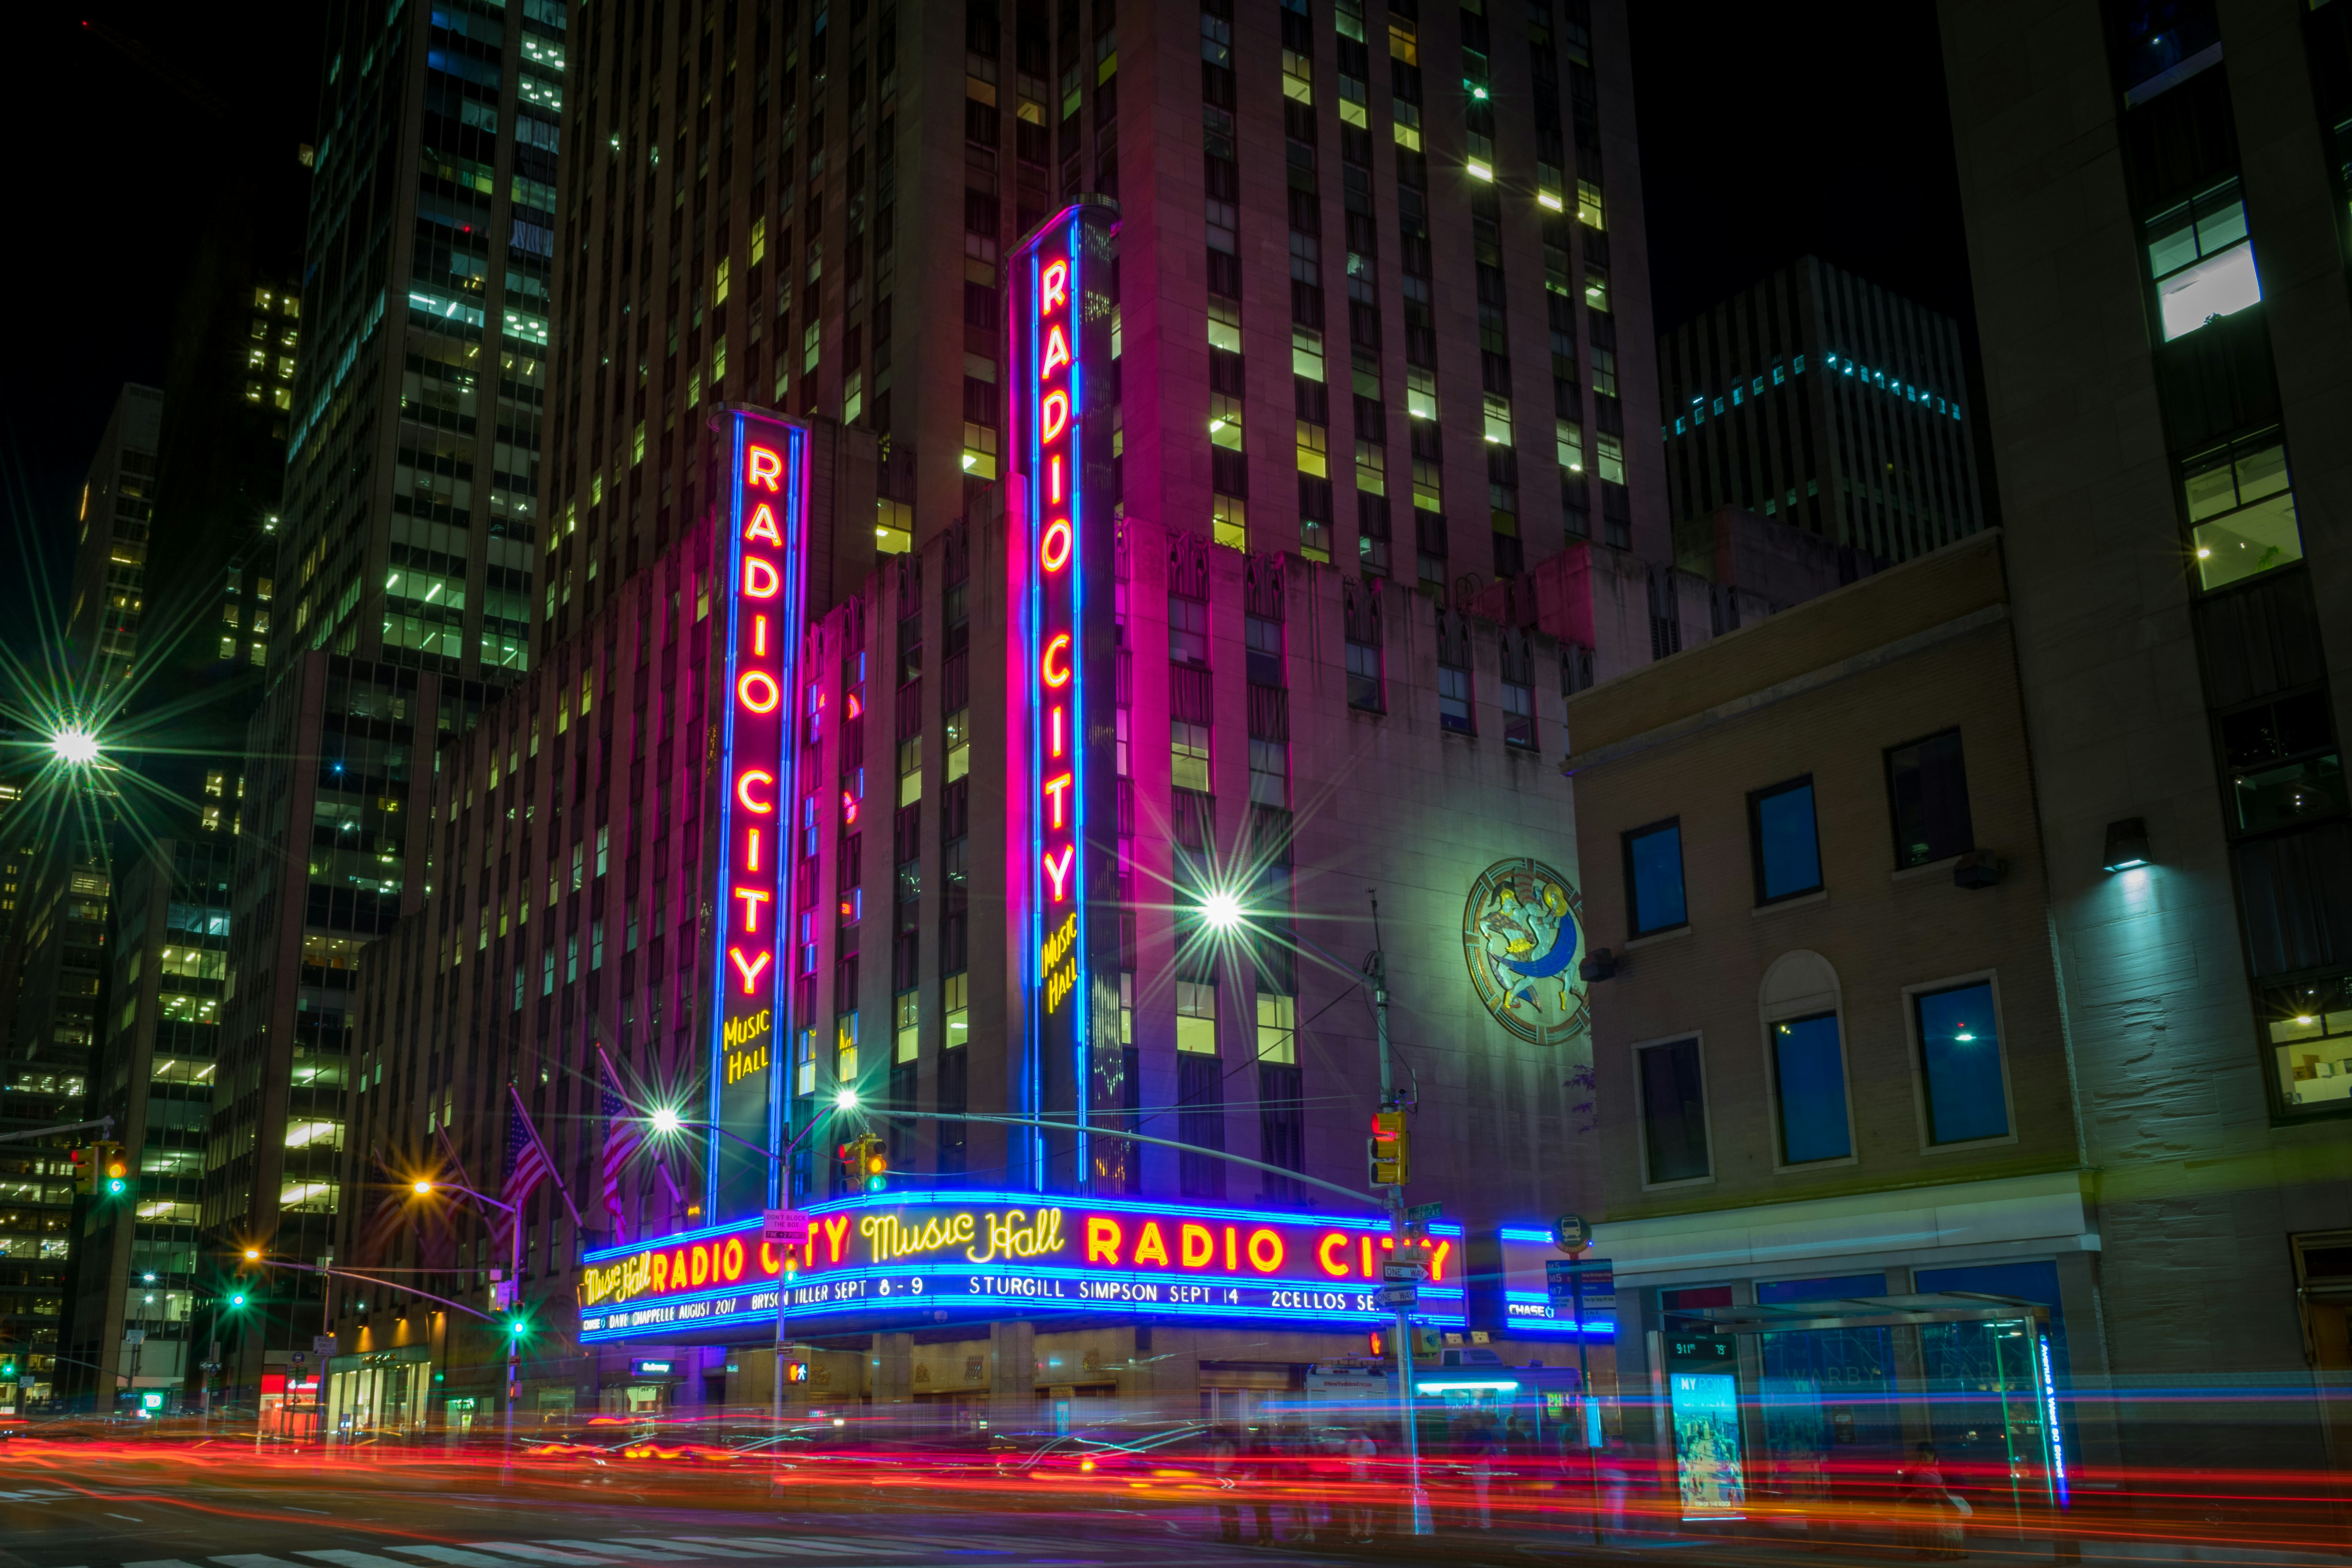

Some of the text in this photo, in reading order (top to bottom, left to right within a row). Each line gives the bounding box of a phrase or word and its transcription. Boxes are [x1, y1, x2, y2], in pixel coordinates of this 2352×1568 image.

[1041, 259, 1074, 902] RADIO CITY
[729, 445, 781, 985] RADIO CITY
[1409, 1208, 1440, 1221] AMERICAS
[861, 1207, 1065, 1264] Music Hall
[1088, 1216, 1285, 1273] RADIO
[652, 1215, 850, 1293] RADIO CTY
[584, 1249, 651, 1306] Music Hall
[1386, 1266, 1424, 1278] ONE WAY
[1549, 1273, 1562, 1283] M5
[795, 1284, 829, 1305] TILLER
[835, 1279, 867, 1300] SEPT
[879, 1278, 890, 1296] 8
[911, 1277, 923, 1295] 9
[969, 1276, 1238, 1305] STURGILL SIMPSON SEPT 14
[1271, 1290, 1346, 1310] 2CELLOS
[1377, 1290, 1412, 1302] ONE WAY
[1550, 1286, 1562, 1295] M7
[609, 1297, 736, 1329] DAVE CHAPPELLE AUGUST 2017
[1508, 1304, 1546, 1317] CHASE
[1676, 1343, 1690, 1354] 9:11
[1785, 1365, 1875, 1386] WARBY
[2040, 1344, 2051, 1384] Avenue
[1674, 1377, 1731, 1391] ANY POINT
[144, 1394, 161, 1408] TD
[2047, 1397, 2058, 1426] West
[2052, 1428, 2060, 1442] 50
[2054, 1444, 2064, 1478] Street
